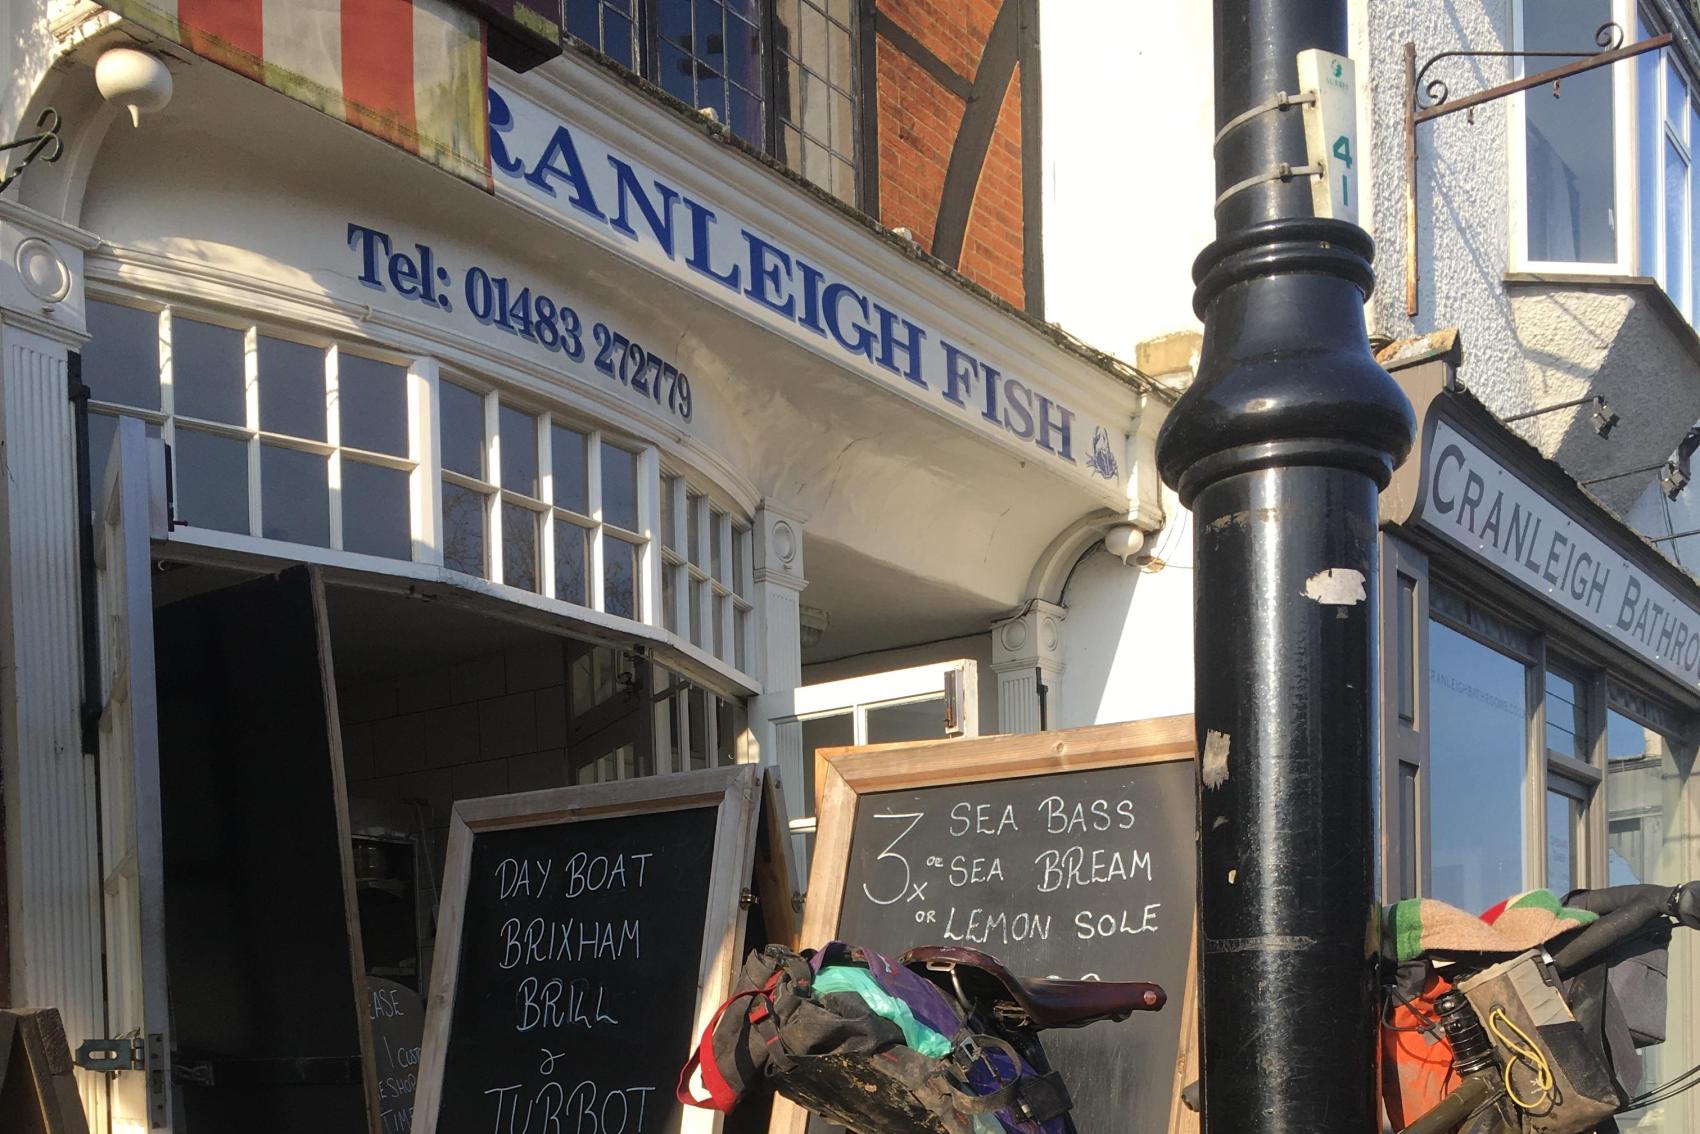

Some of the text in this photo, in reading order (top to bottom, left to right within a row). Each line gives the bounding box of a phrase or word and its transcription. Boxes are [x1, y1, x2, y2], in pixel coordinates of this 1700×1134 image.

[347, 222, 693, 424] Tel: 01483 272779
[940, 339, 1077, 466] FISH
[1432, 444, 1700, 681] CRANLEIGH BATHRO
[950, 802, 1018, 836] SEA
[1038, 796, 1136, 834] BASS
[495, 852, 653, 900] DAY BOAT
[949, 855, 1004, 887] SEA
[1035, 846, 1152, 892] BREAM
[499, 917, 640, 969] BRIXHAM
[915, 903, 1161, 944] OR LEMON SOLE
[516, 977, 619, 1031] BRILL
